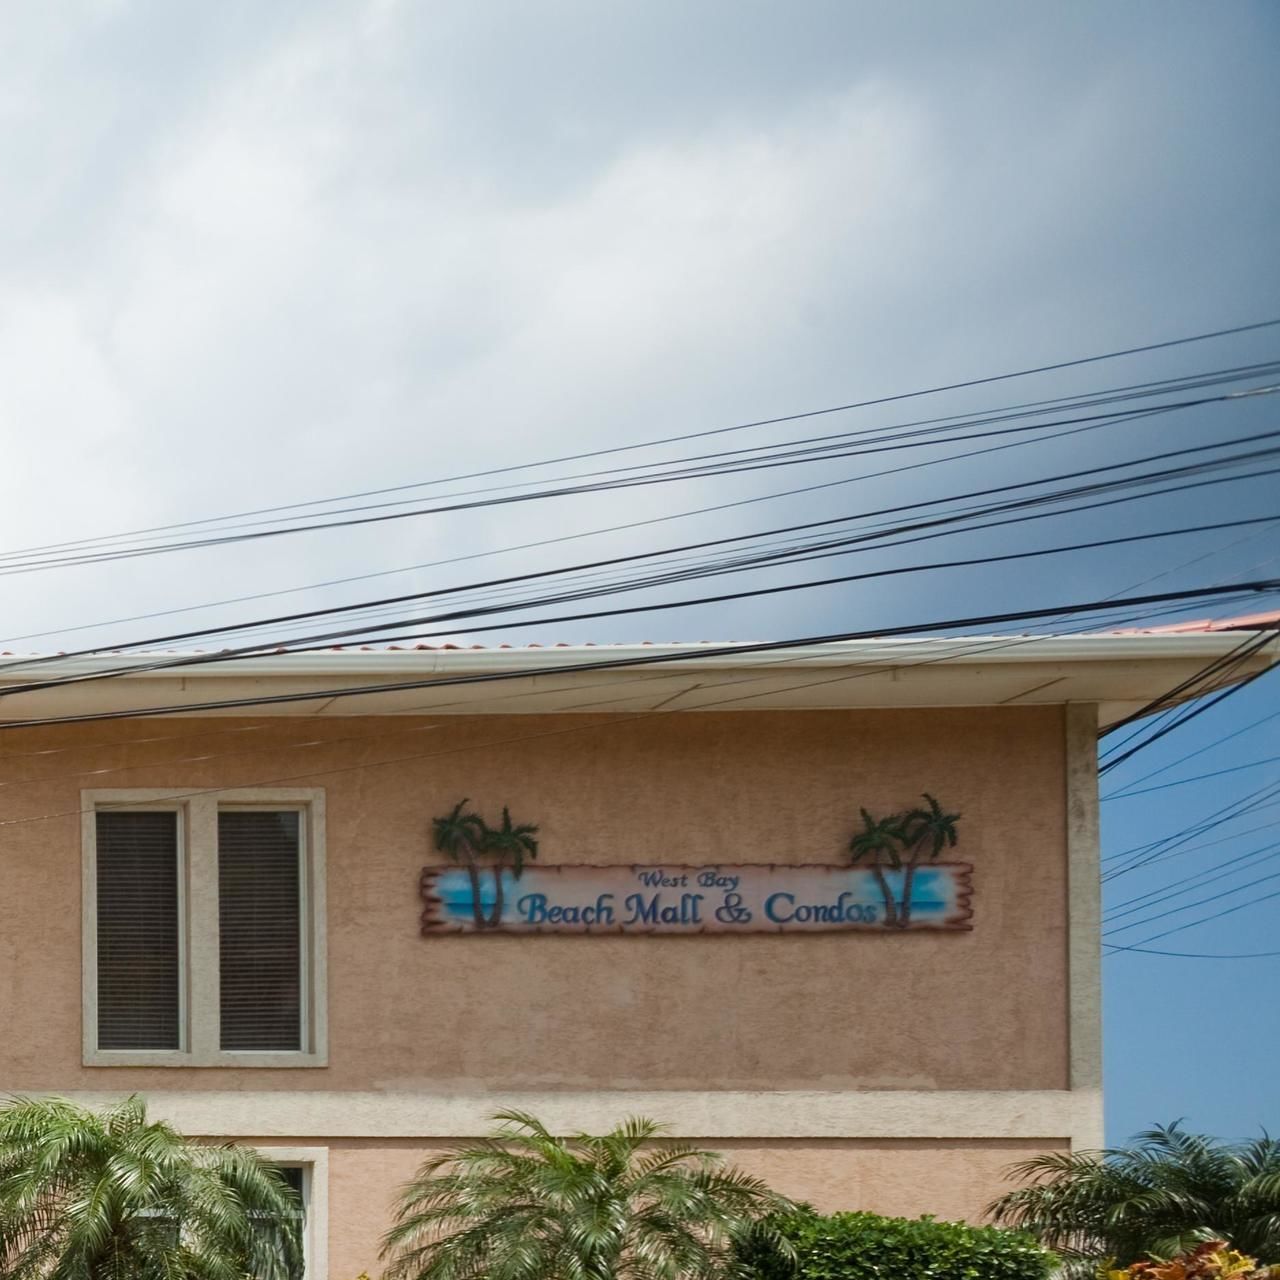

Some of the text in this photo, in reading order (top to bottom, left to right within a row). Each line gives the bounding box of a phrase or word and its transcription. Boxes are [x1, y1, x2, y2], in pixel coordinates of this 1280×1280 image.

[639, 871, 740, 893] West Bay
[517, 892, 879, 925] Beach Mall & Condos
